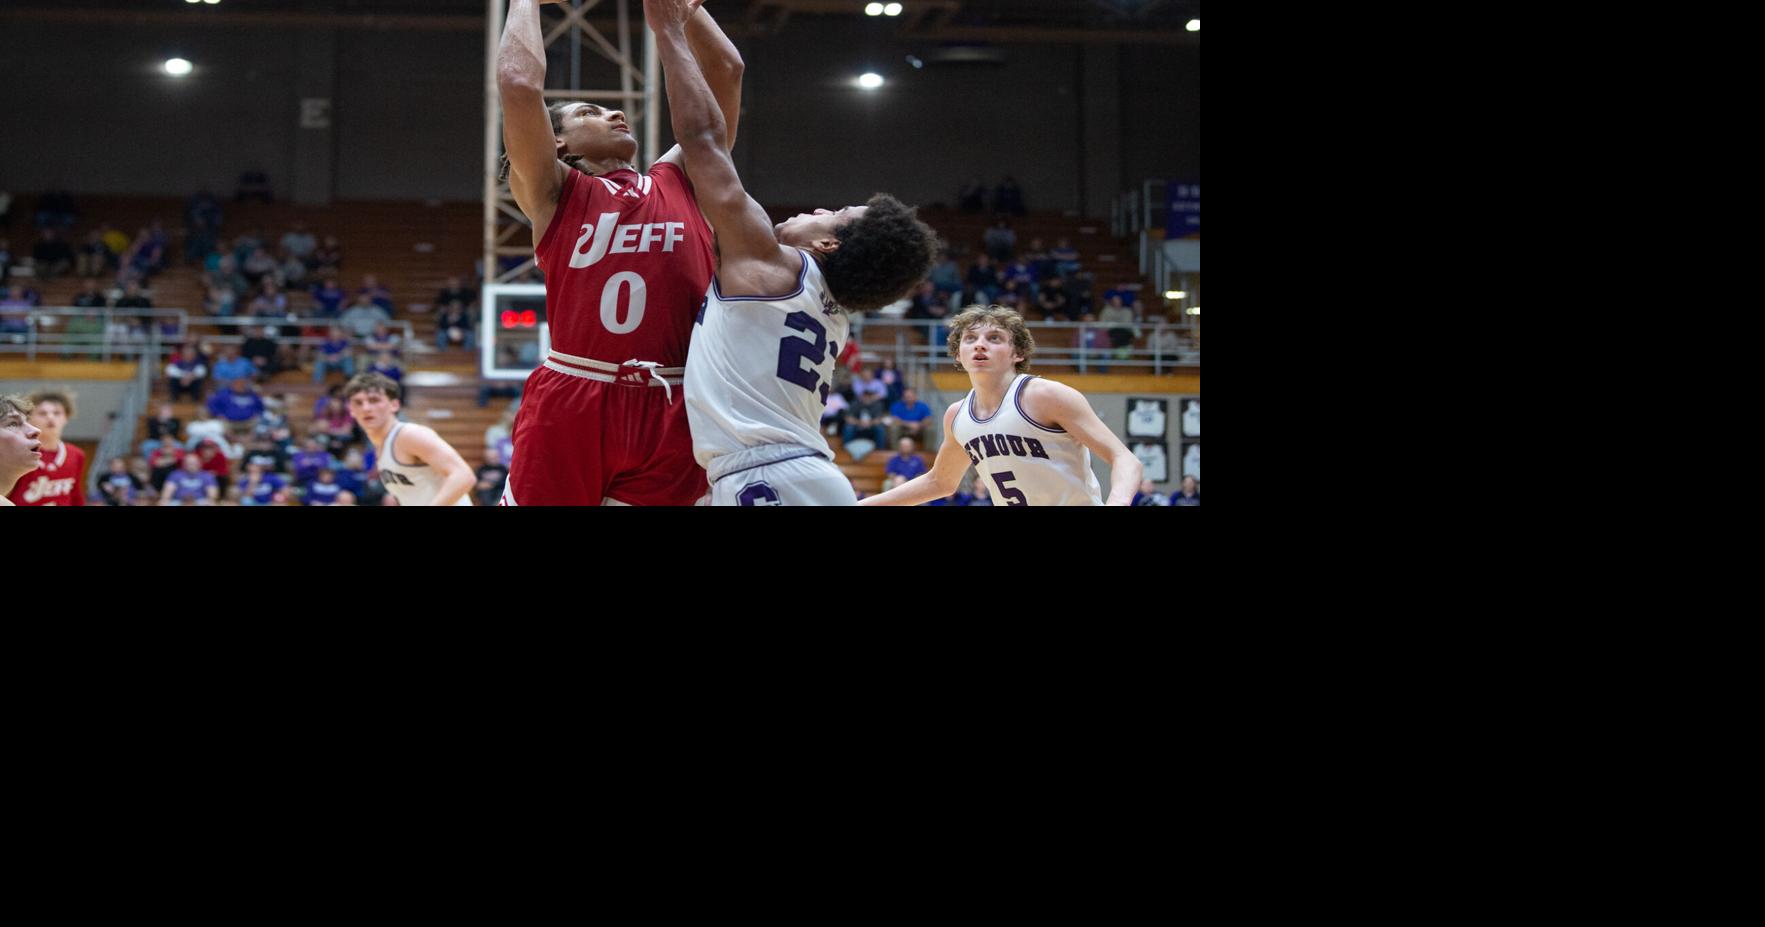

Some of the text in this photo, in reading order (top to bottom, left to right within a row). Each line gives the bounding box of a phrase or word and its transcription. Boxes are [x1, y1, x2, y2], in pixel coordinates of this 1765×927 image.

[568, 212, 684, 269] JEFF
[600, 271, 647, 335] 0
[964, 433, 1050, 466] EYMOUR
[991, 471, 1028, 506] 5
